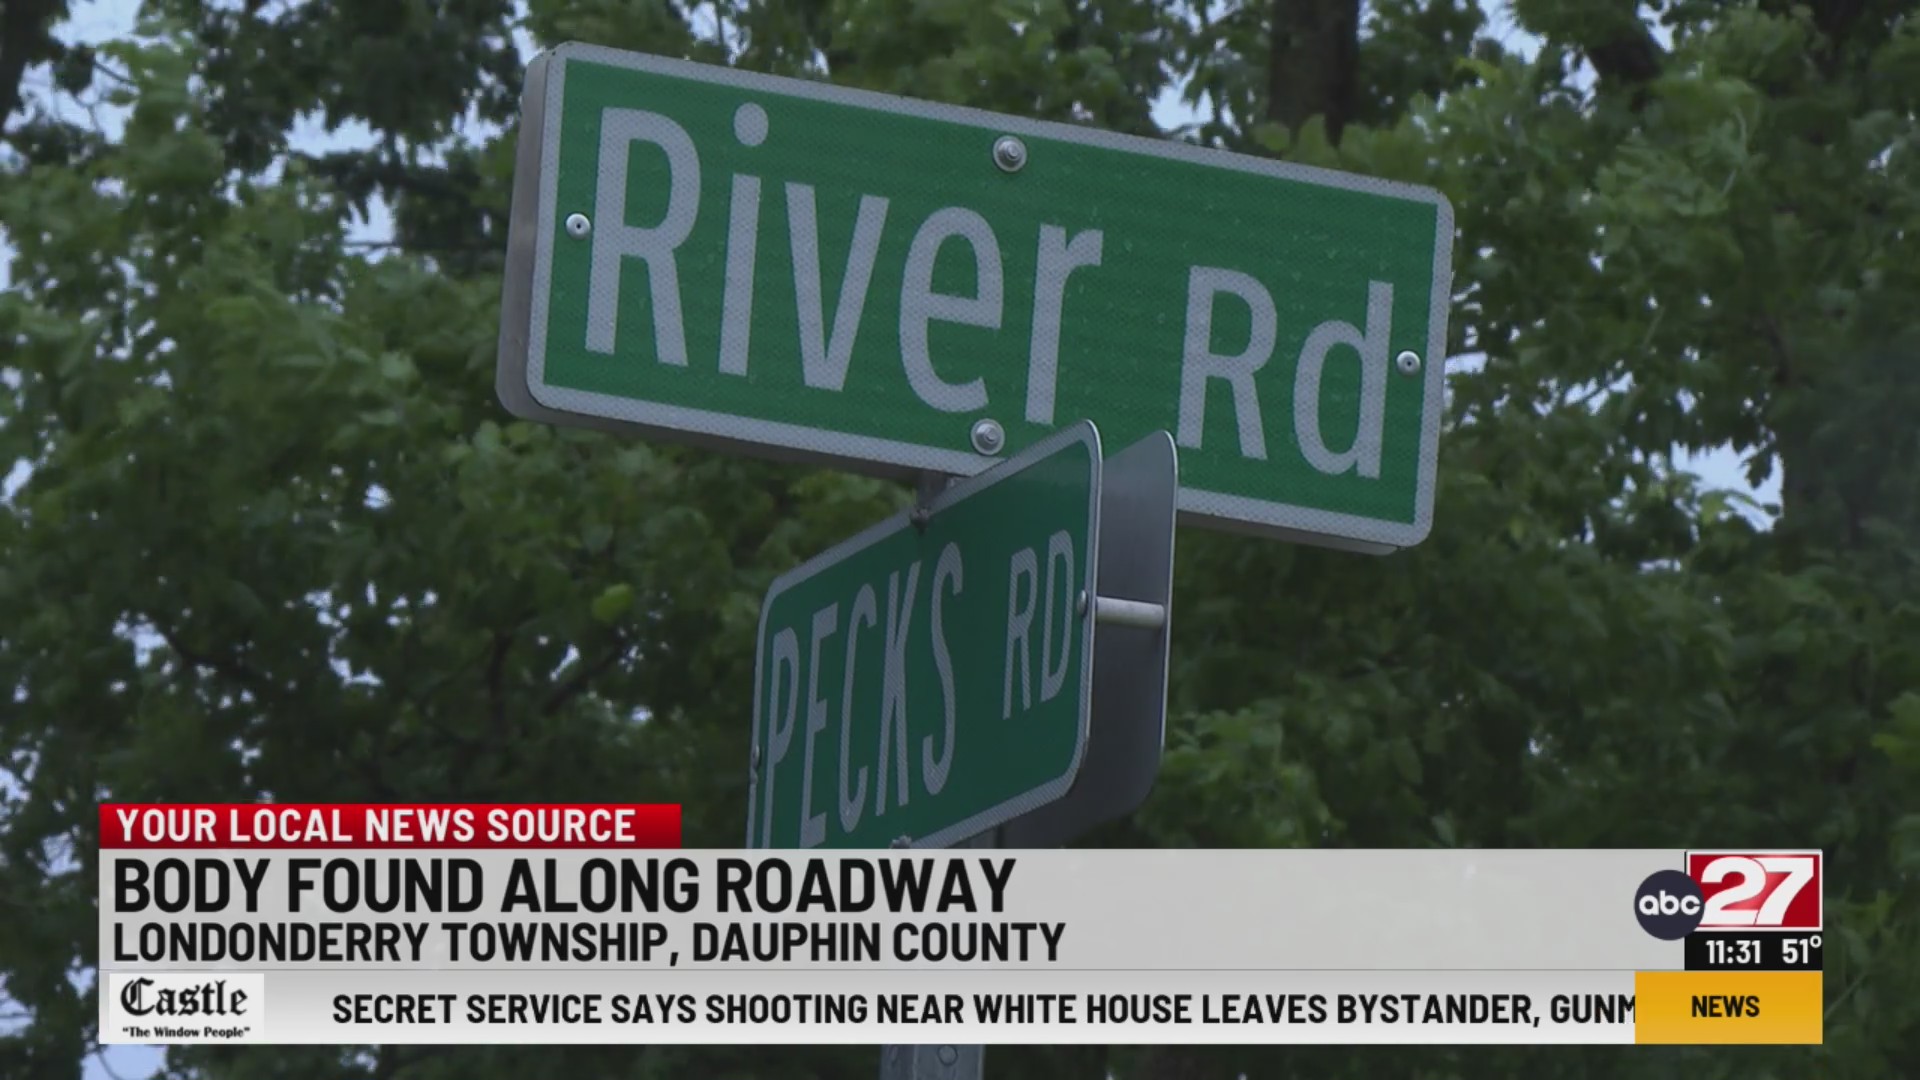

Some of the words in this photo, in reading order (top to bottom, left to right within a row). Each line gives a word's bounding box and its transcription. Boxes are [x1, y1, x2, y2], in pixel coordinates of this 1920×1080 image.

[585, 102, 1103, 425] River
[1177, 264, 1395, 479] Rd
[762, 541, 963, 848] PECKS
[1003, 529, 1074, 720] RD
